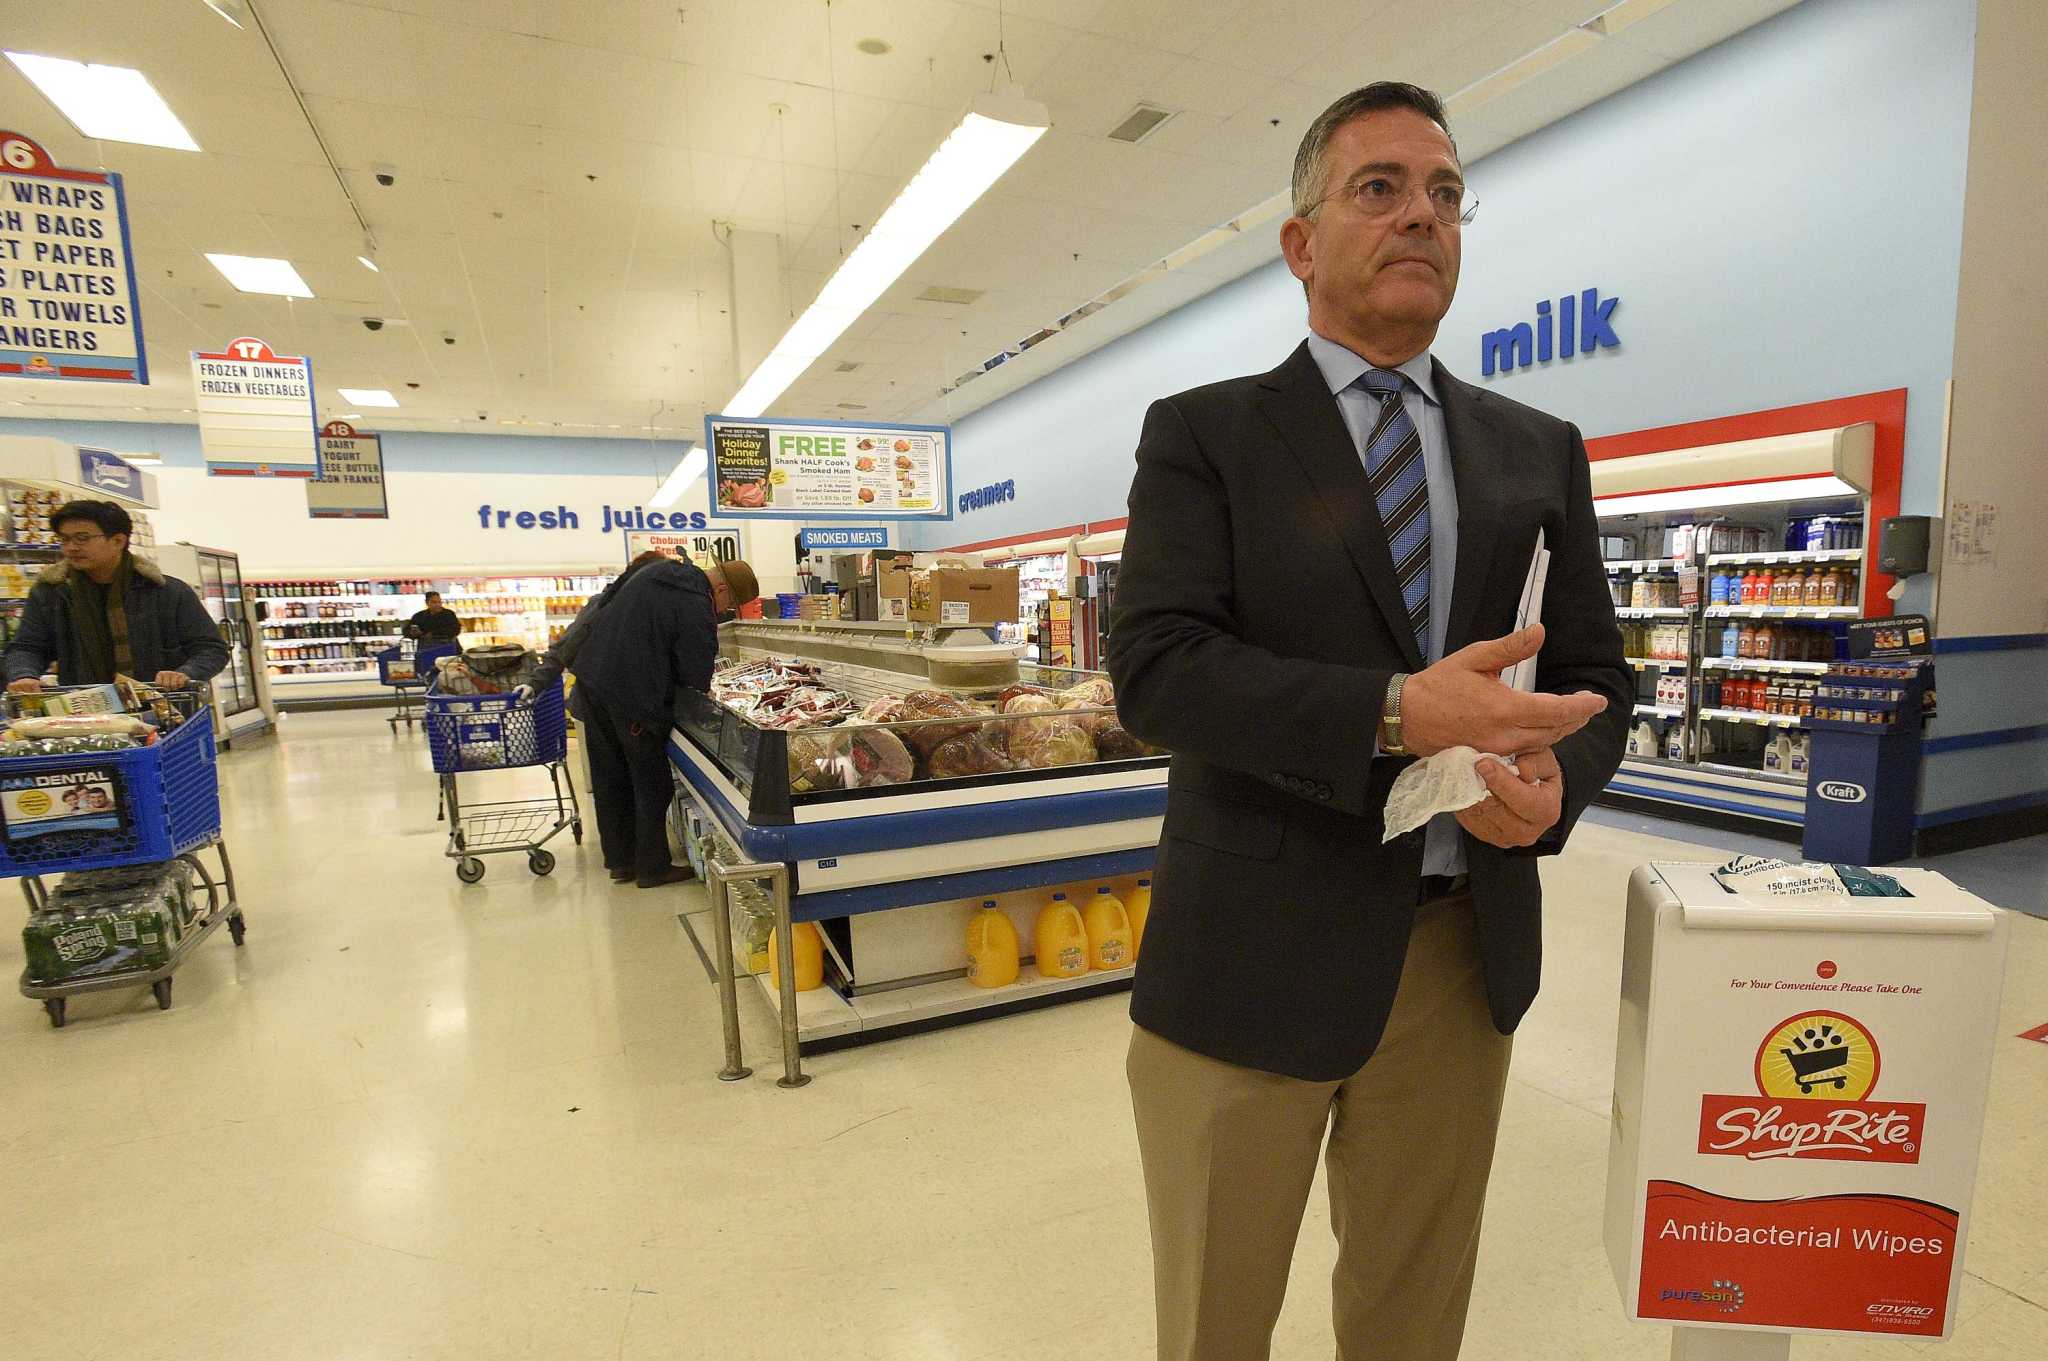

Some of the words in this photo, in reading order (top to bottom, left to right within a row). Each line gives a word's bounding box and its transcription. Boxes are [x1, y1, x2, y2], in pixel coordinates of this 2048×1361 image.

[0, 140, 36, 170] 6
[36, 213, 104, 240] BAGS
[35, 241, 116, 269] PAPER
[28, 299, 127, 325] TOWELS
[1482, 288, 1622, 376] milk
[235, 342, 264, 359] 17
[200, 364, 248, 378] FROZEN
[253, 366, 305, 381] DINNERS
[202, 380, 241, 394] FROZEN
[245, 382, 306, 398] VEGETABLES
[328, 423, 350, 436] 18
[326, 440, 355, 449] DAIRY
[722, 439, 762, 450] Holiday
[725, 448, 760, 457] Dinner
[779, 435, 847, 457] FREE
[323, 452, 361, 460] YOGURT
[717, 457, 769, 466] Favorites!
[825, 459, 850, 467] Cook's
[346, 463, 380, 473] BUTTER
[834, 467, 851, 475] Ham
[344, 475, 380, 484] FRANKS
[959, 479, 1015, 513] creamers
[478, 504, 579, 529] fresh
[602, 504, 707, 533] juices
[650, 535, 688, 545] Chobani
[807, 532, 848, 544] SMOKED
[850, 532, 883, 544] MEATS
[36, 771, 110, 786] DENTAL
[1826, 784, 1856, 799] Kraft
[1767, 881, 1783, 891] 150
[53, 924, 103, 949] Poland
[58, 935, 107, 961] Spring
[1730, 979, 1747, 989] For
[1750, 979, 1773, 989] Your
[1774, 980, 1838, 992] Convenience
[1840, 982, 1873, 993] Please
[1876, 983, 1899, 994] Take
[1901, 984, 1923, 995] One
[1709, 1105, 1910, 1156] ShopRite
[1659, 1219, 1841, 1250] Antibacterial
[1851, 1229, 1944, 1257] Wipes
